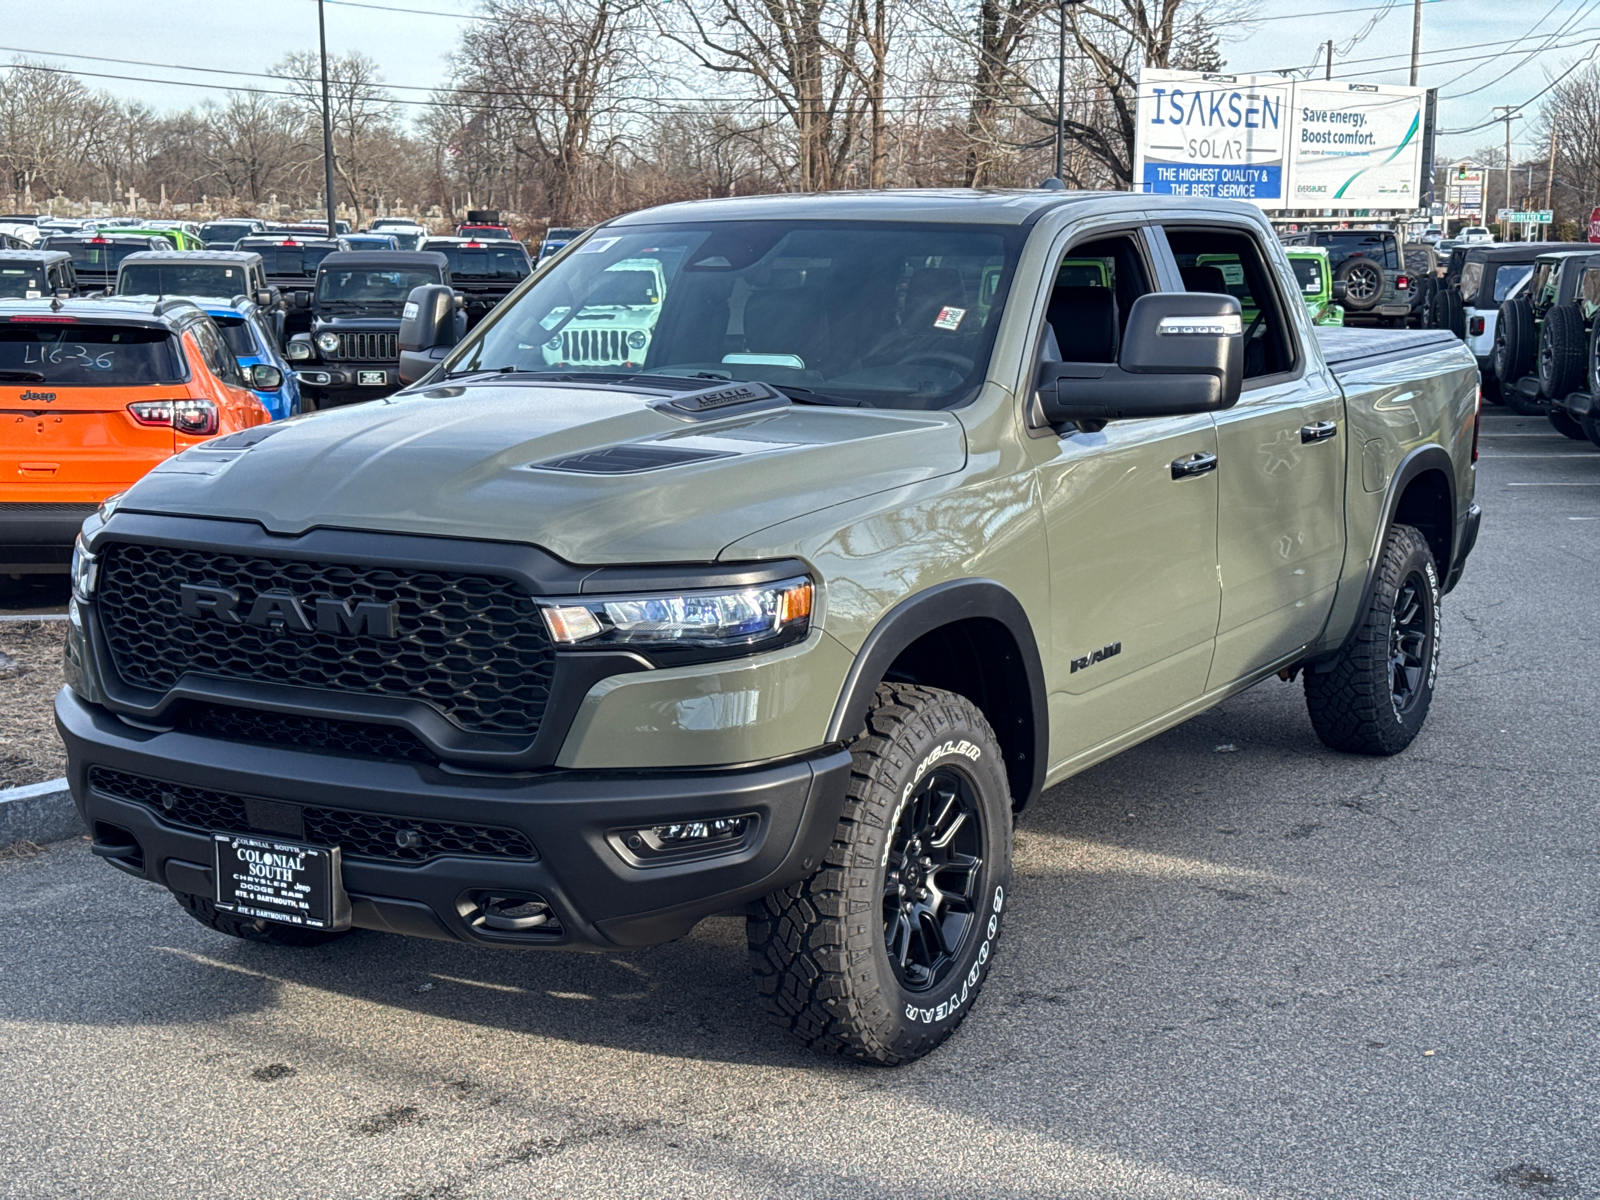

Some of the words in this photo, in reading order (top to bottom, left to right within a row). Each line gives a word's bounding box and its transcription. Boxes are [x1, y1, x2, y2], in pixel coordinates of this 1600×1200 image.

[1151, 88, 1280, 130] ISAKSEN
[1302, 107, 1328, 123] Save
[1329, 111, 1367, 128] energy.
[1301, 128, 1332, 144] Boost
[1333, 130, 1376, 145] comfort.
[1188, 139, 1242, 159] SOLAR
[1157, 168, 1177, 181] THE
[1179, 168, 1219, 181] HIGHEST
[1222, 169, 1259, 182] QUALITY
[1261, 170, 1268, 182] &
[1170, 184, 1189, 195] THE
[1191, 184, 1216, 197] BEST
[1217, 184, 1256, 197] SERVICE
[1589, 220, 1600, 238] STO
[24, 345, 114, 368] L16-36
[20, 390, 56, 403] Jeep
[180, 583, 399, 638] RAM
[1070, 641, 1122, 674] RAM
[236, 838, 271, 849] COLONIAL
[274, 844, 300, 854] SOUTH
[237, 848, 305, 871] COLONIAL
[249, 863, 293, 882] SOUTH
[233, 873, 287, 888] CHRYSLER
[294, 882, 311, 893] Jeep
[240, 882, 274, 894] DODGE
[235, 890, 249, 899] RTE.
[257, 894, 298, 908] DARTMOUTH,
[299, 901, 310, 909] MA
[256, 910, 292, 923] DARTMOUTH,
[905, 886, 1003, 1023] GOODYEAR
